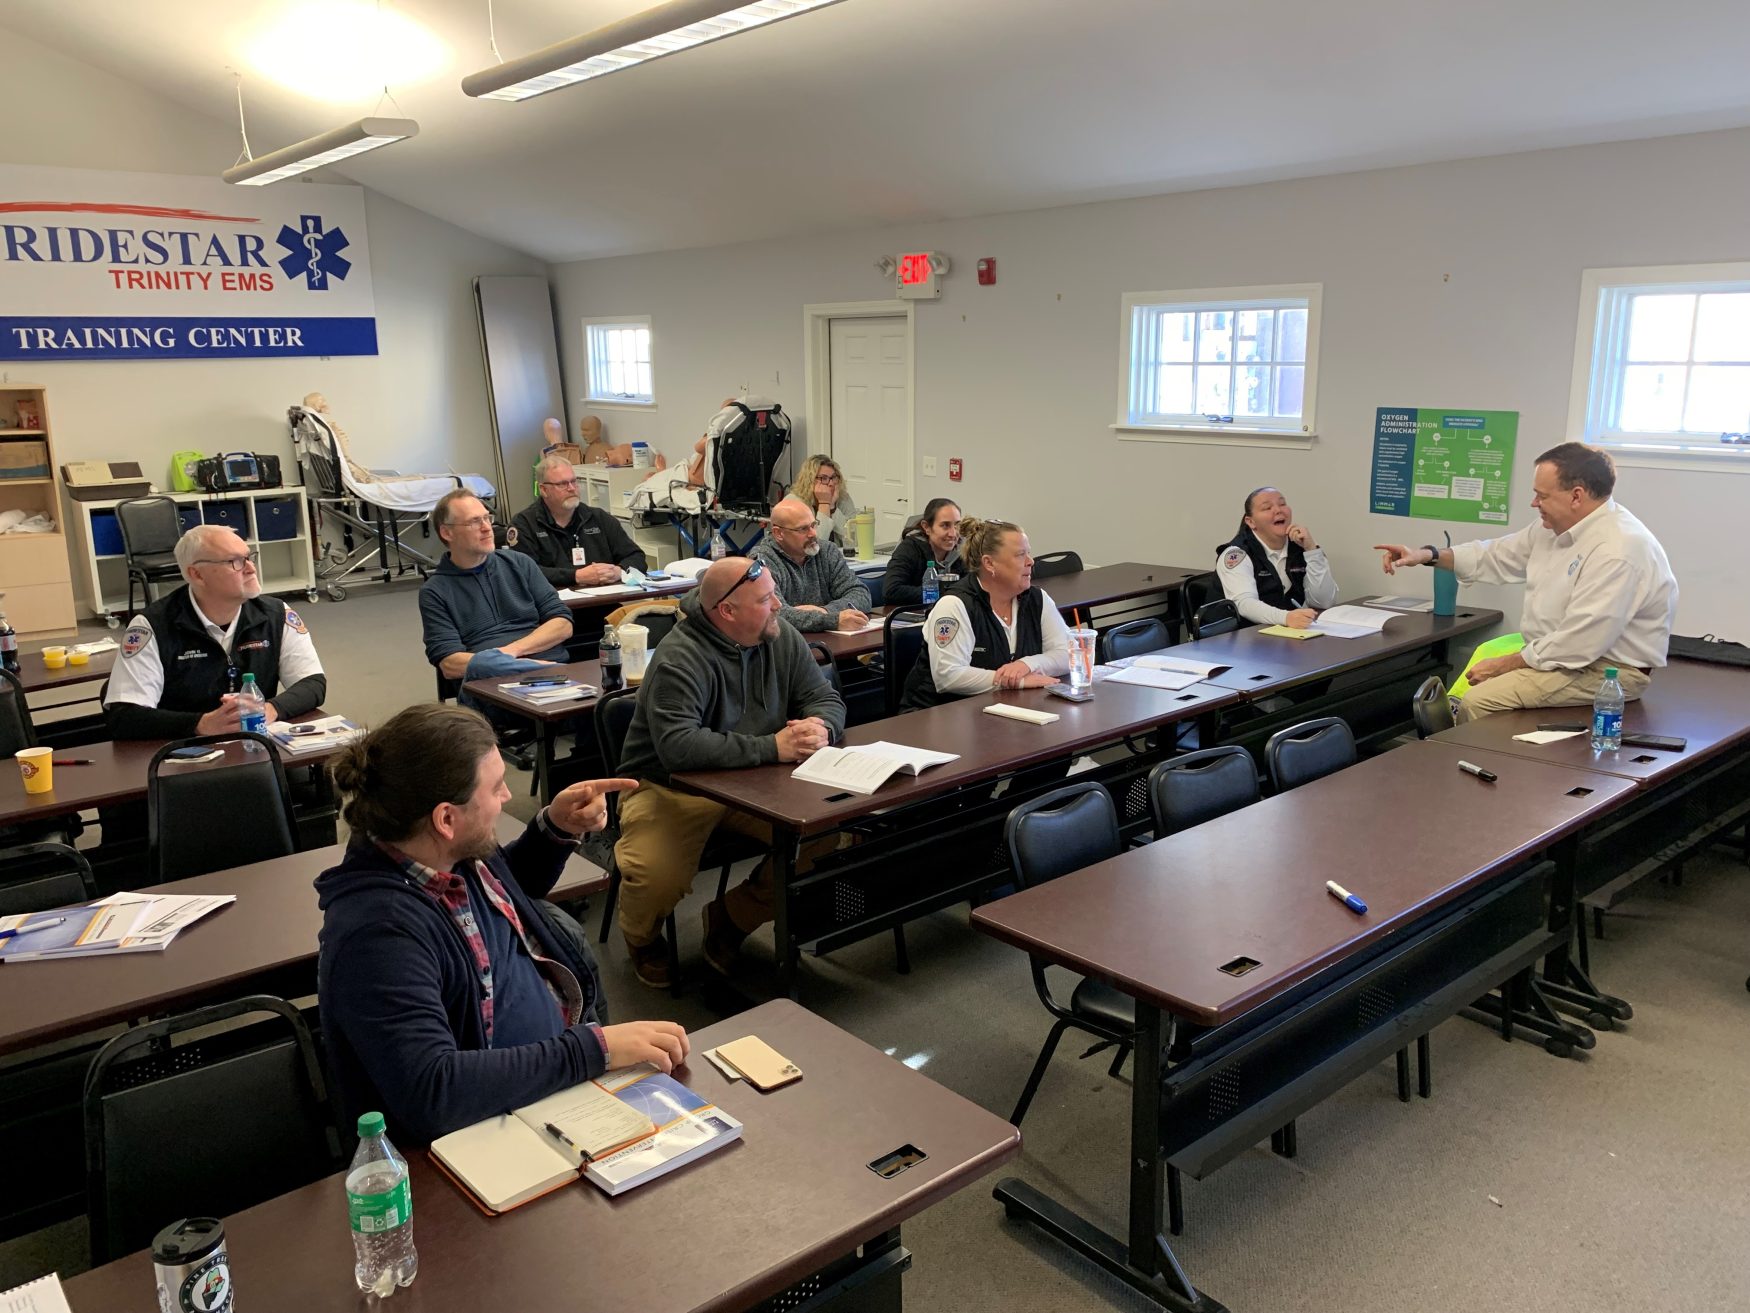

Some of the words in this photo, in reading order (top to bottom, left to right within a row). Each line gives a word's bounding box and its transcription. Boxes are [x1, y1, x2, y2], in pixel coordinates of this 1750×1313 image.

[1, 224, 272, 268] RIDESTAR
[108, 269, 213, 291] TRINITY
[221, 272, 274, 292] EMS
[12, 327, 177, 350] TRAINING
[188, 327, 305, 348] CENTER
